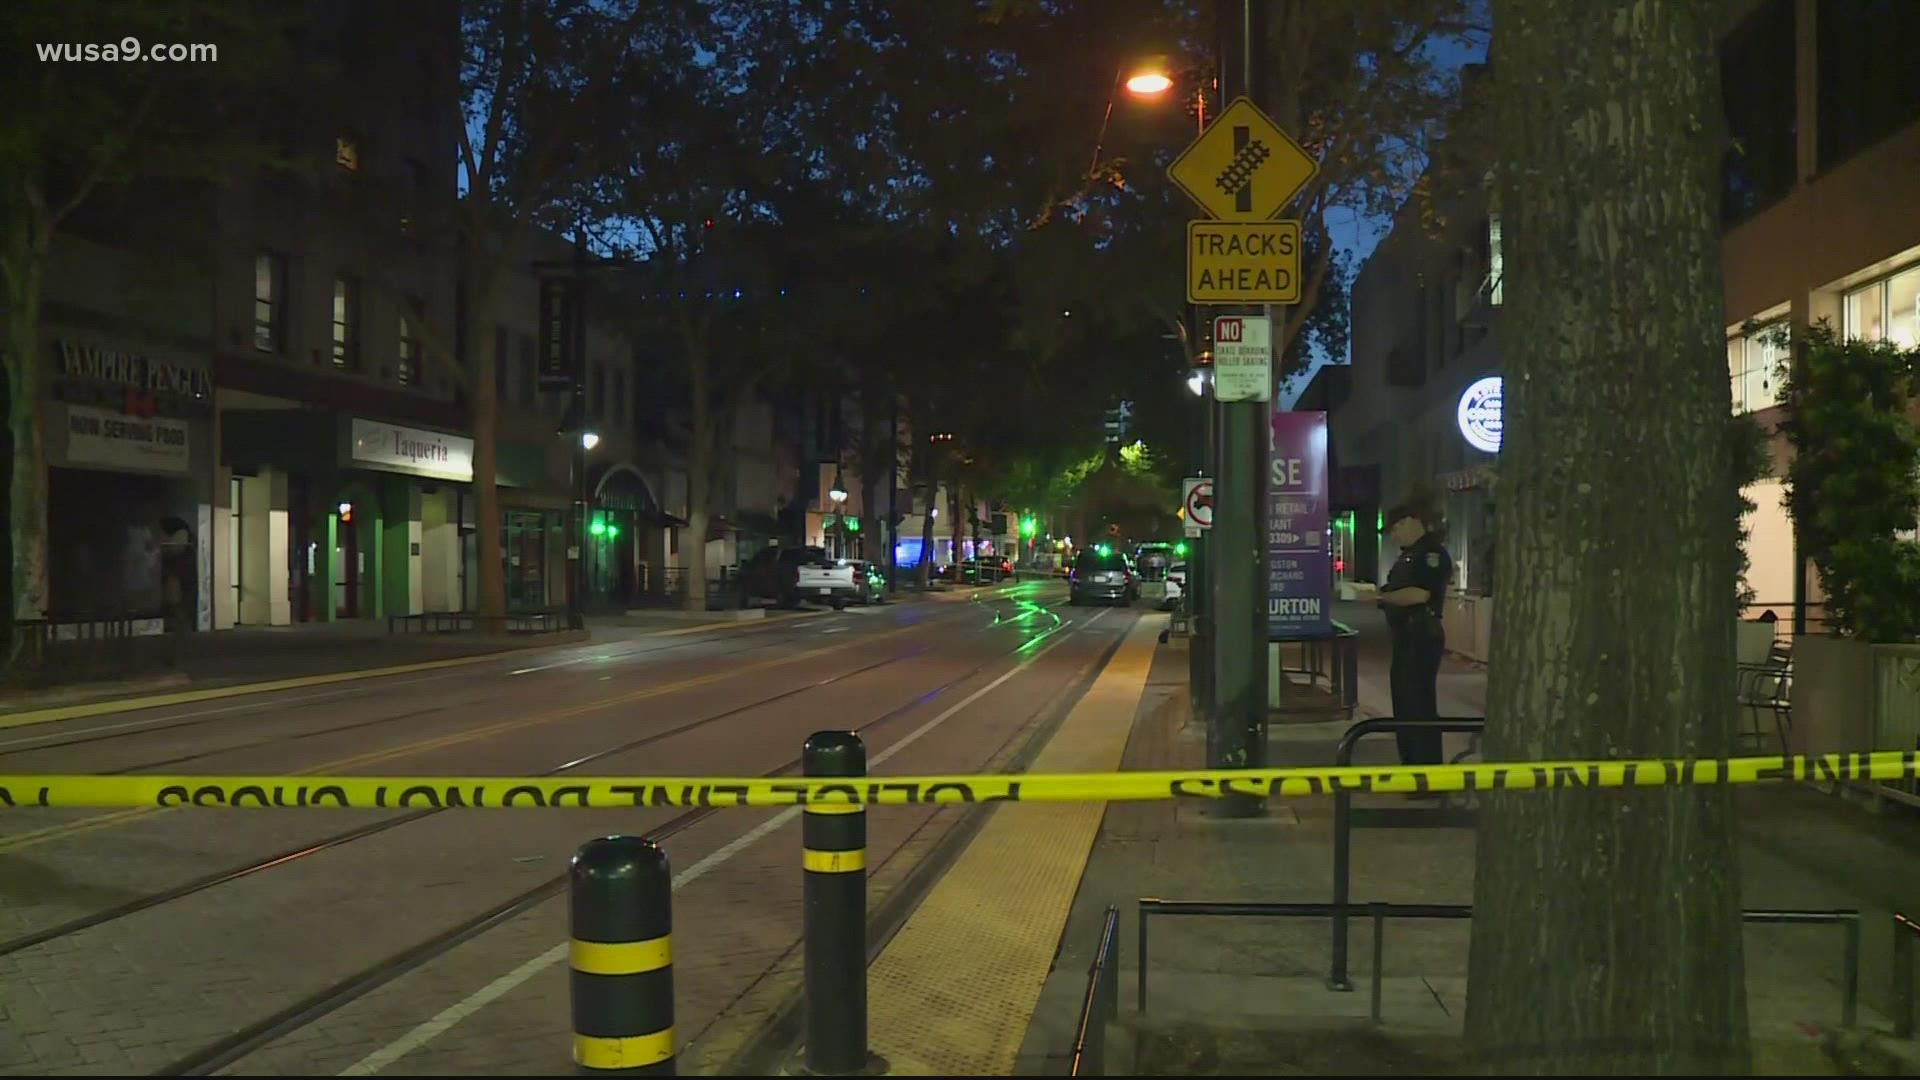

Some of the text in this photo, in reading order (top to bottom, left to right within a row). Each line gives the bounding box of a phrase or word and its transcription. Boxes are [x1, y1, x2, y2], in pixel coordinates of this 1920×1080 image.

[1195, 233, 1294, 256] TRACKS
[1198, 269, 1291, 291] AHEAD
[1221, 321, 1239, 340] NO
[61, 339, 141, 384] VAMPIRE
[70, 414, 185, 446] NOW SERVING FOOD
[393, 430, 448, 463] Taqueria
